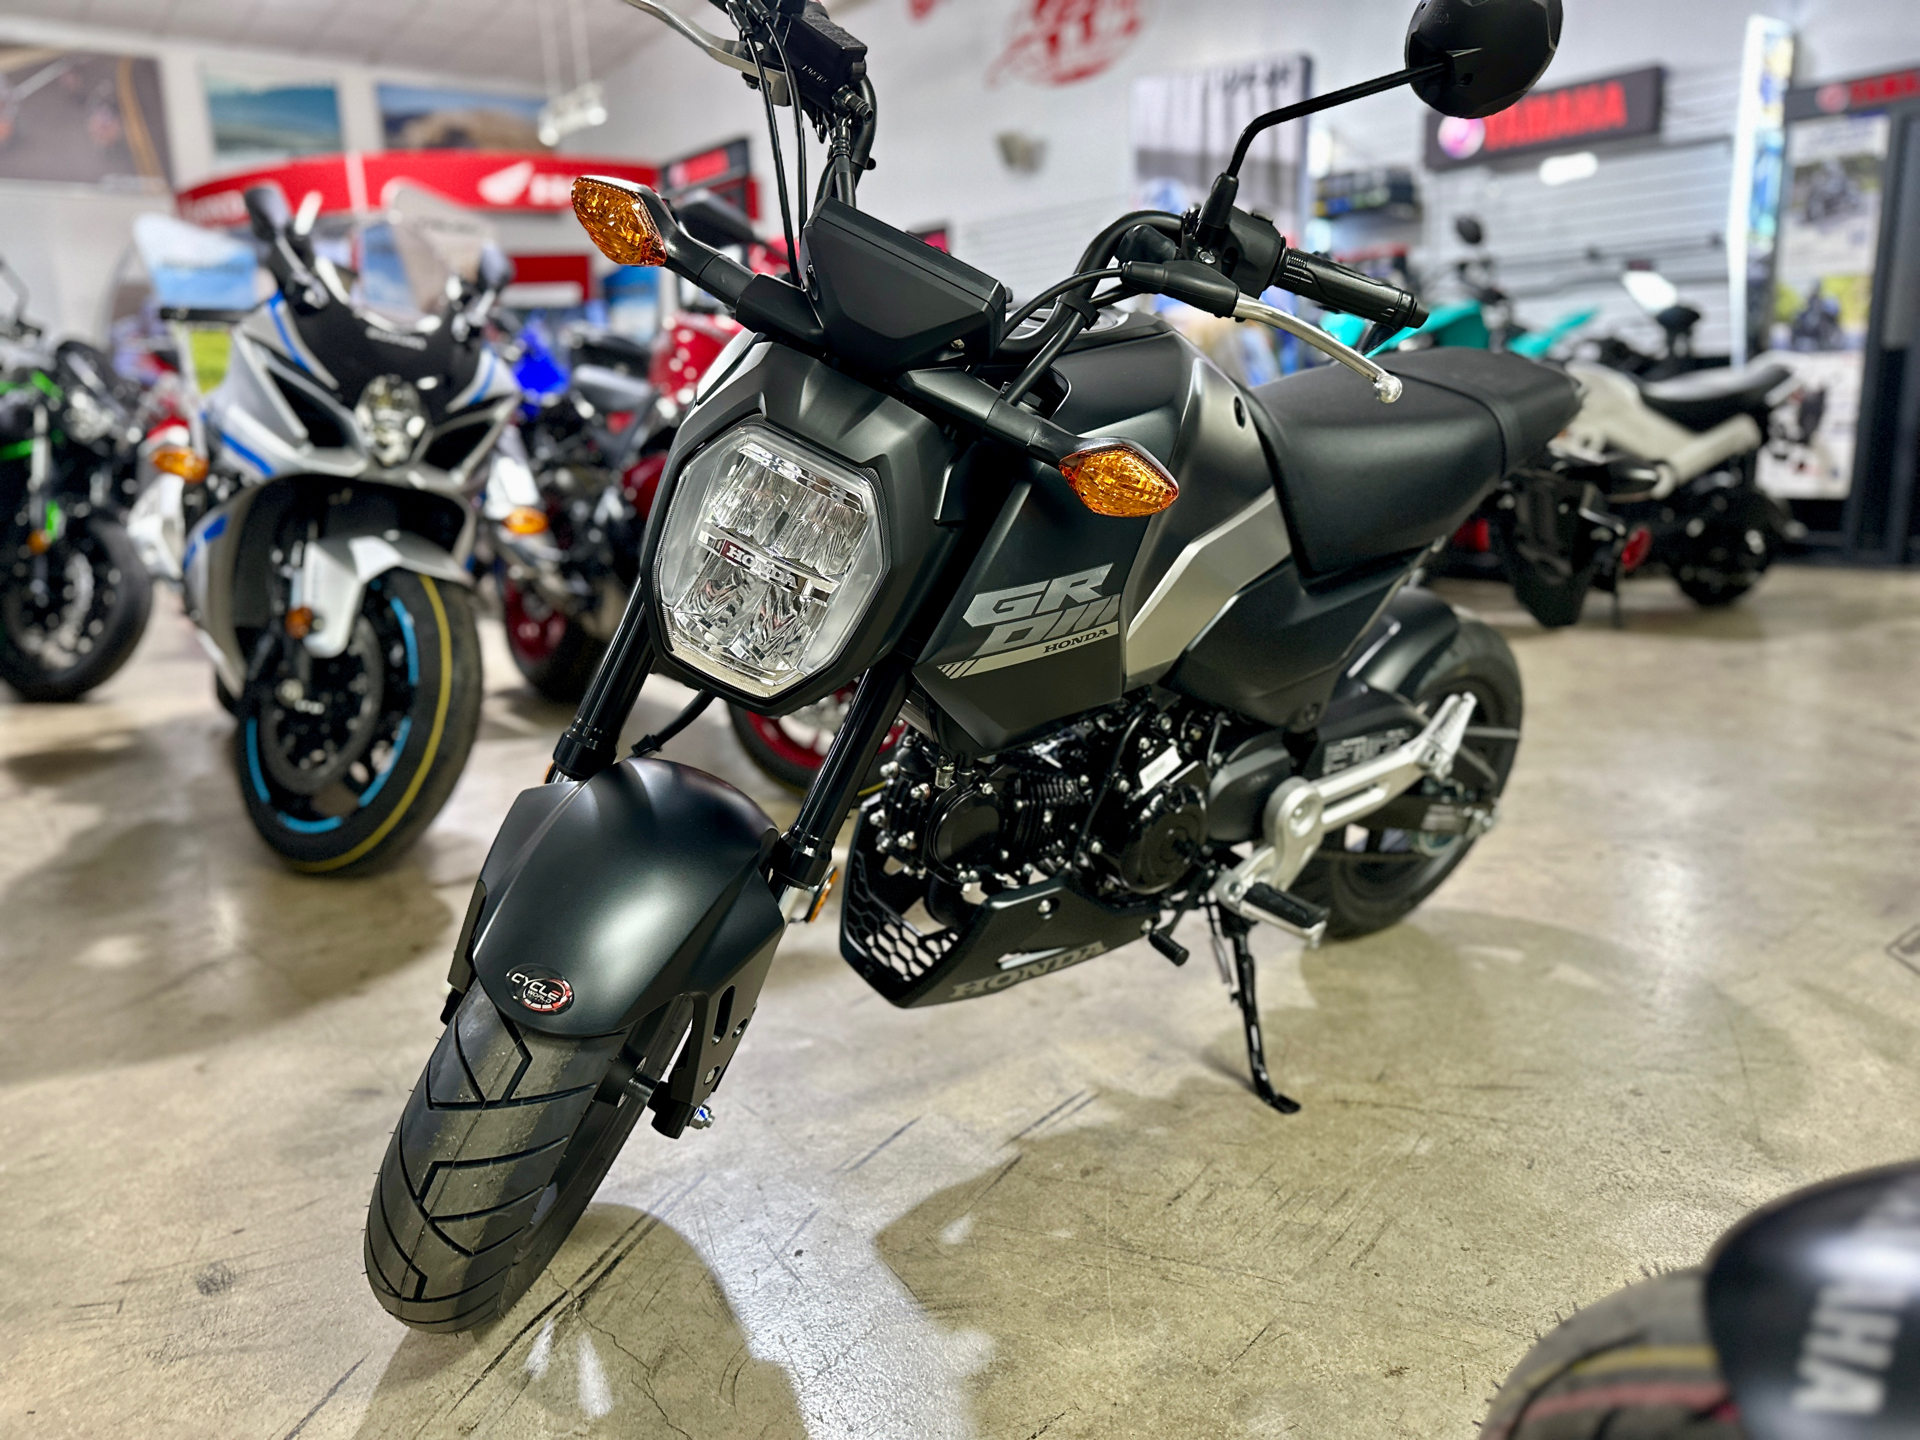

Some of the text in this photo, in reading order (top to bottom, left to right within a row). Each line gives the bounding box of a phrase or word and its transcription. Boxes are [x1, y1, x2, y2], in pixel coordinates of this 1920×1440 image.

[726, 544, 798, 590] HONDA
[1043, 628, 1110, 653] HONDA
[949, 940, 1108, 998] HONDA
[511, 972, 562, 1002] CYCLE
[526, 989, 552, 1004] WORLD
